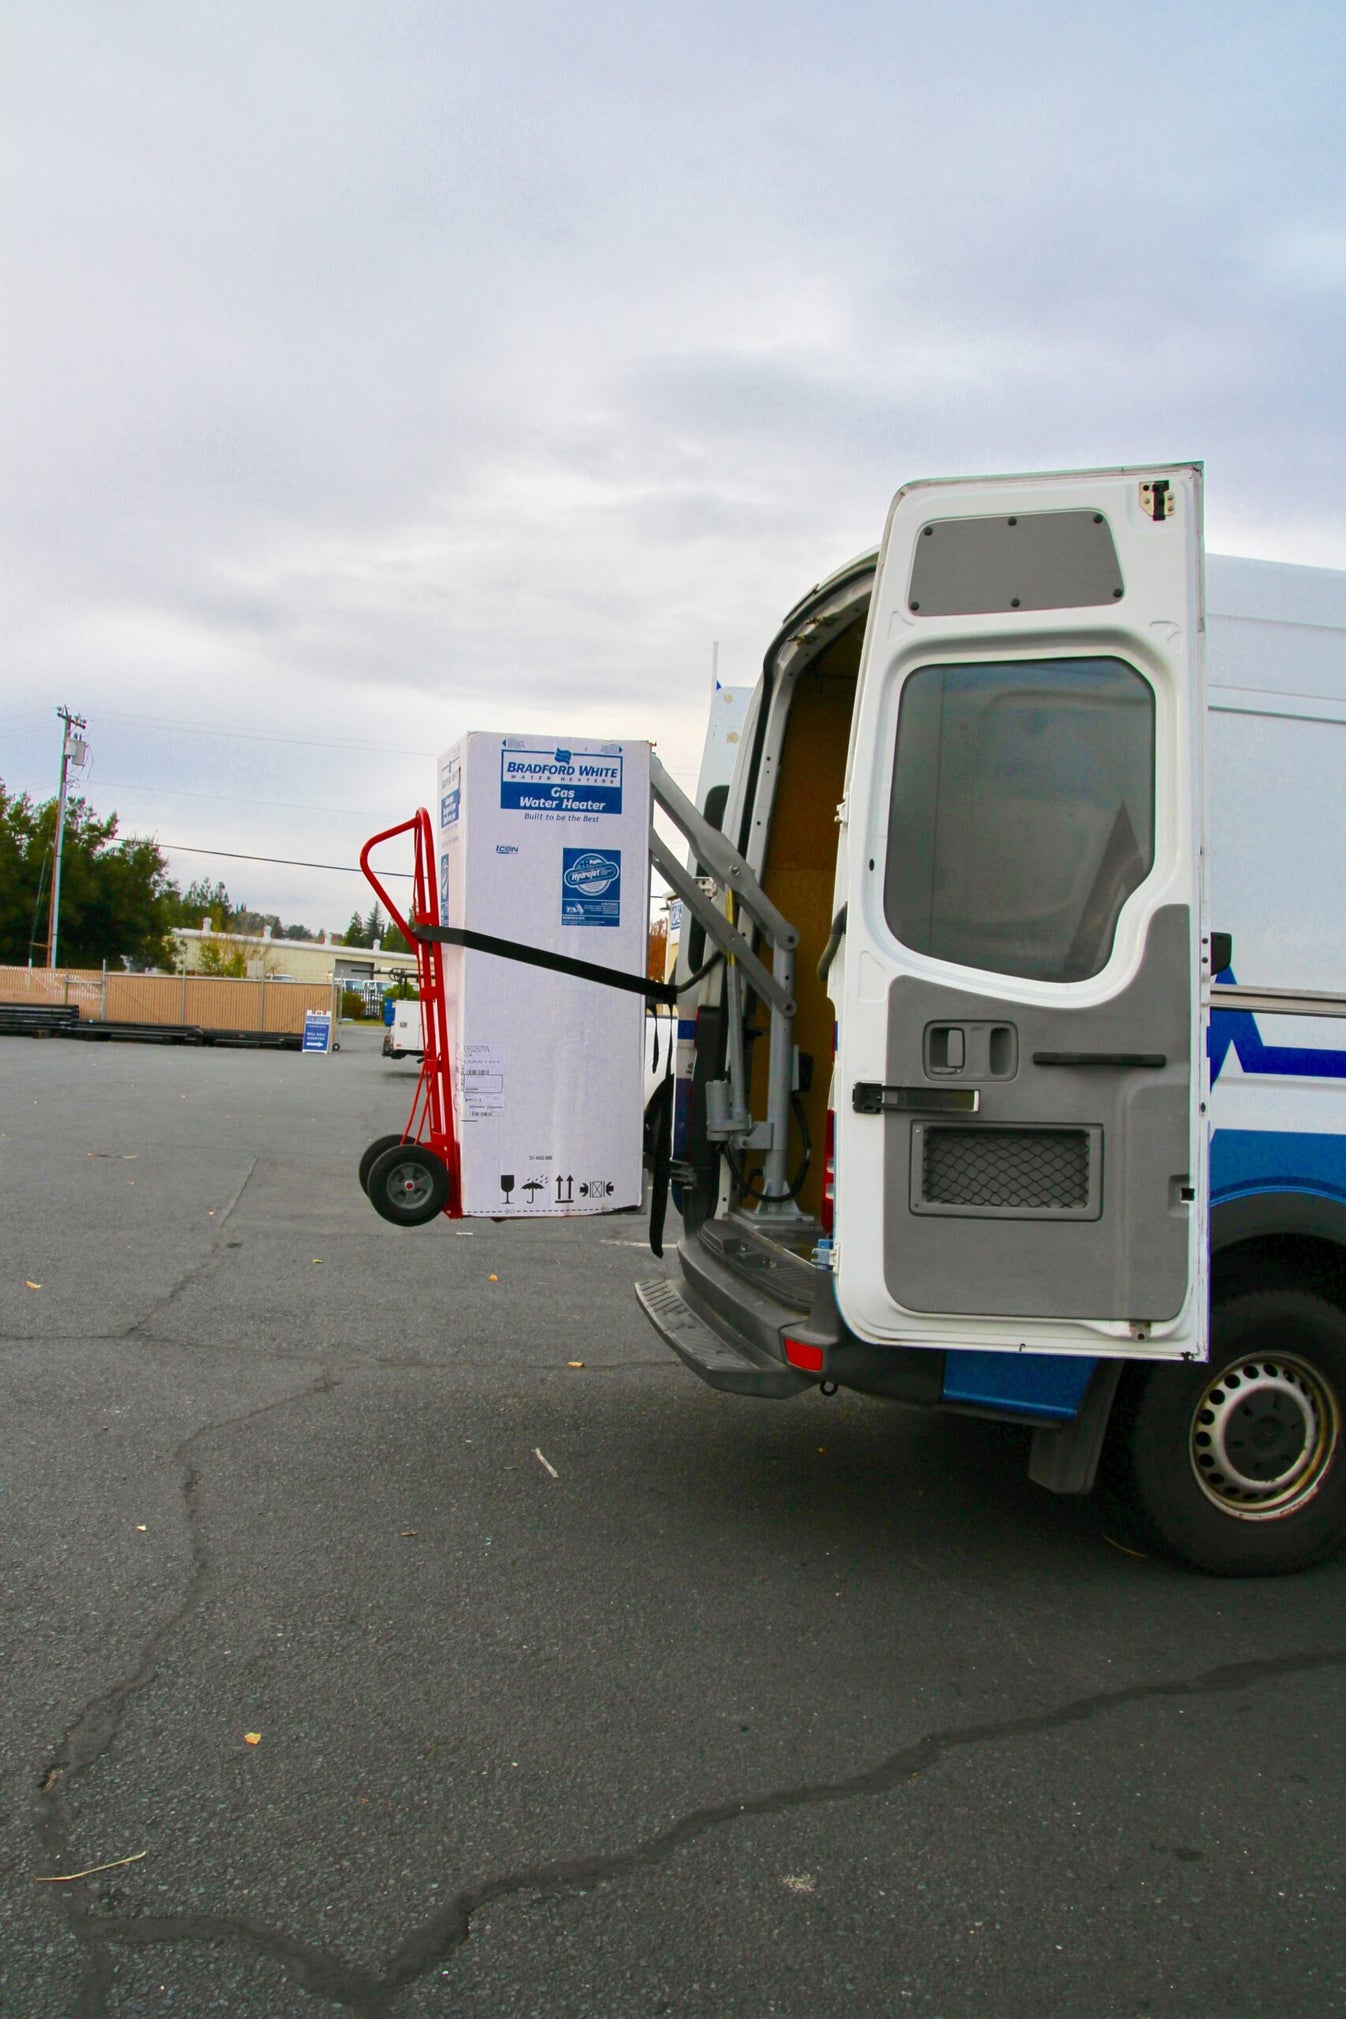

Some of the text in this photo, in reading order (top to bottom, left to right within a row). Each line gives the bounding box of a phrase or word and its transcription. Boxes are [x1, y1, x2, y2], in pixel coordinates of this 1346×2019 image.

[507, 762, 618, 778] BRADFORD WHITE
[551, 787, 575, 798] Gas
[519, 796, 606, 810] Water Heater
[524, 812, 543, 820] Built
[556, 813, 566, 821] be
[568, 814, 581, 822] the
[583, 814, 600, 823] Best
